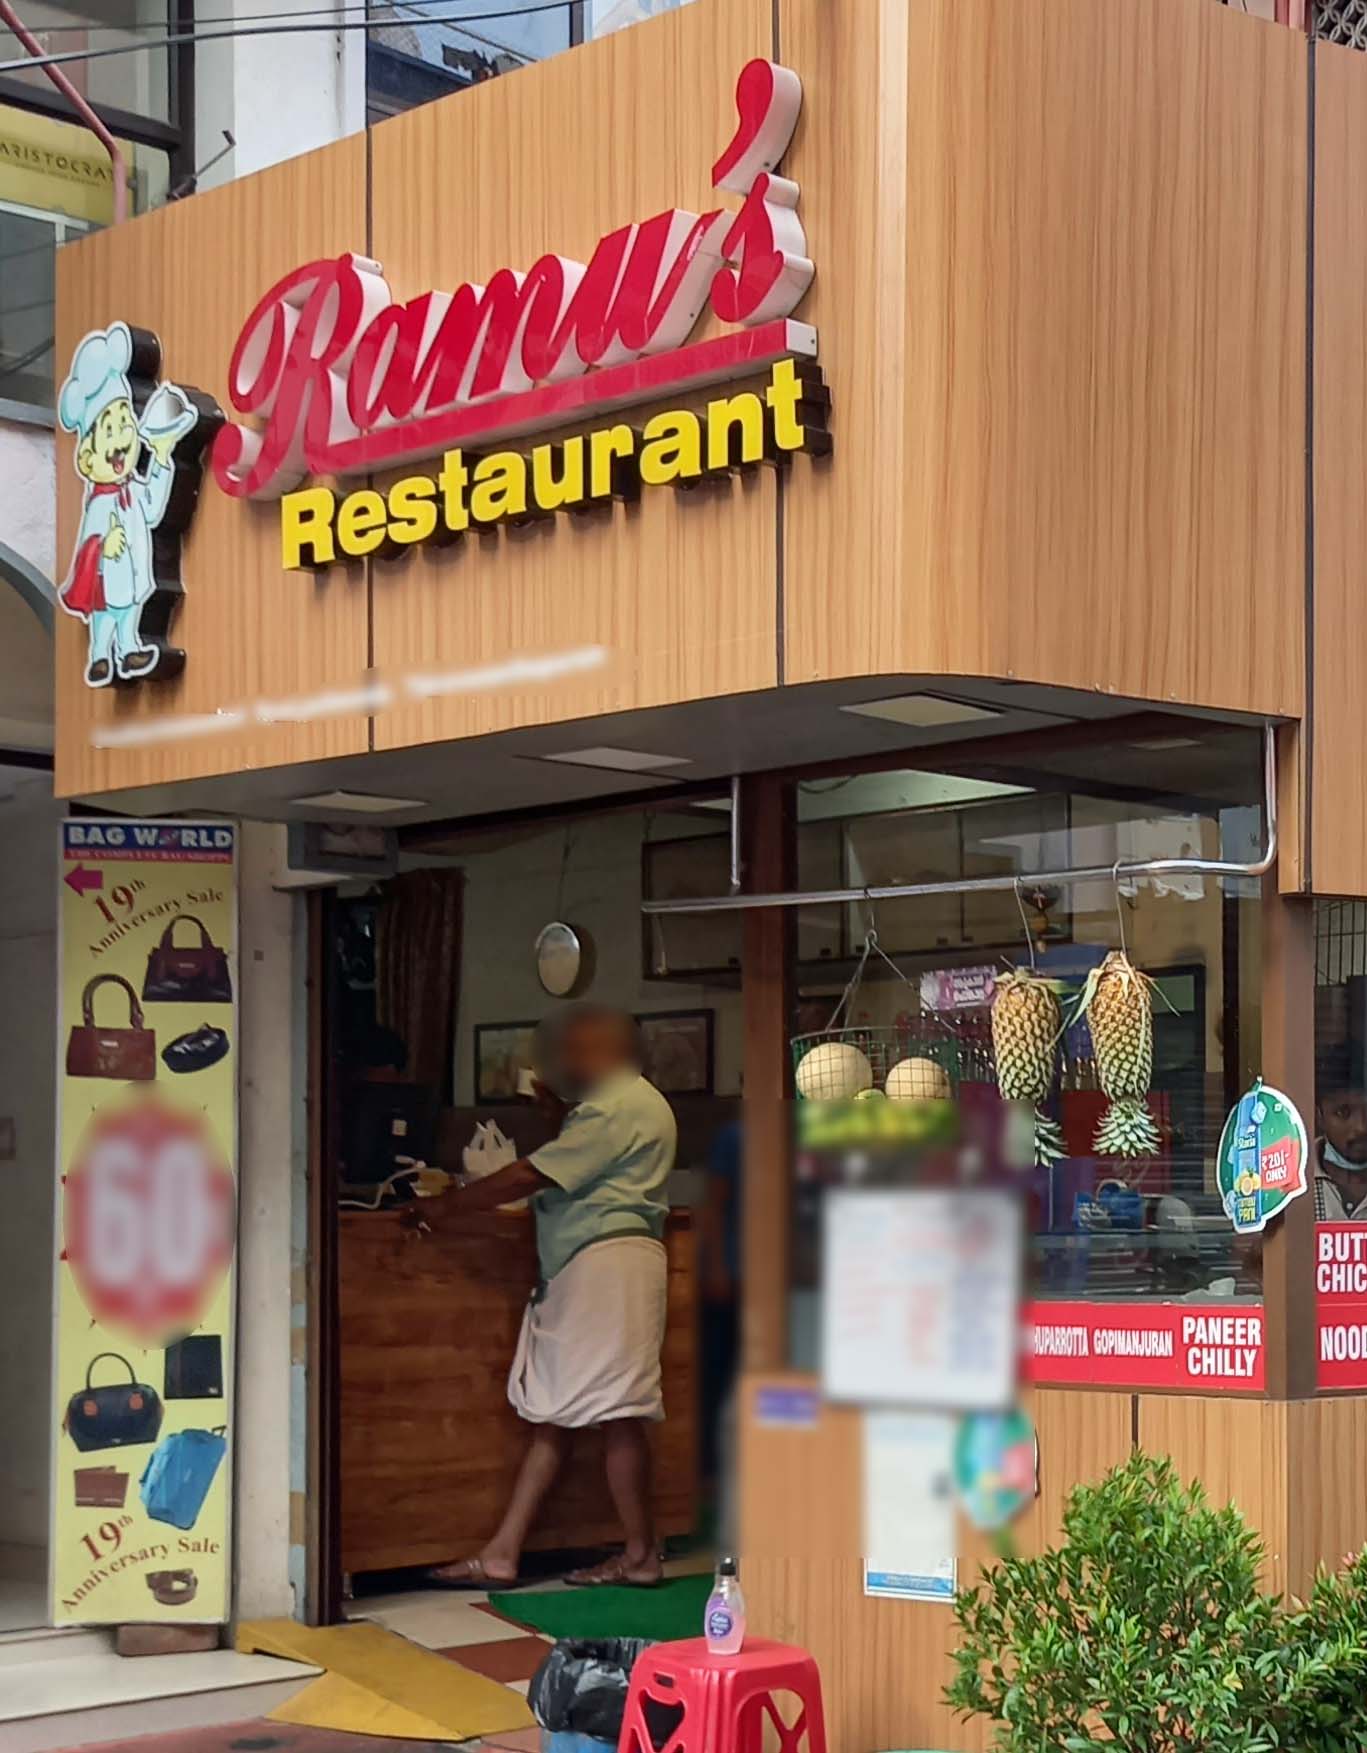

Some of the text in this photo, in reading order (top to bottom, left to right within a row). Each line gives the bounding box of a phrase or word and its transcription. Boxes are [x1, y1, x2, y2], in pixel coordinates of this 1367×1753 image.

[212, 58, 815, 498] Ramu's
[282, 357, 804, 570] Restaurant
[69, 826, 126, 845] BAG
[88, 887, 223, 958] Anniversary Sale
[94, 879, 146, 924] 19th
[1265, 1166, 1287, 1183] ONLY
[1093, 1328, 1173, 1357] GOPIMANJURAN
[1183, 1316, 1262, 1345] PANEER
[1187, 1349, 1257, 1377] CHILLY
[80, 1514, 134, 1562] 19th
[61, 1536, 220, 1614] Anniversary Sale
